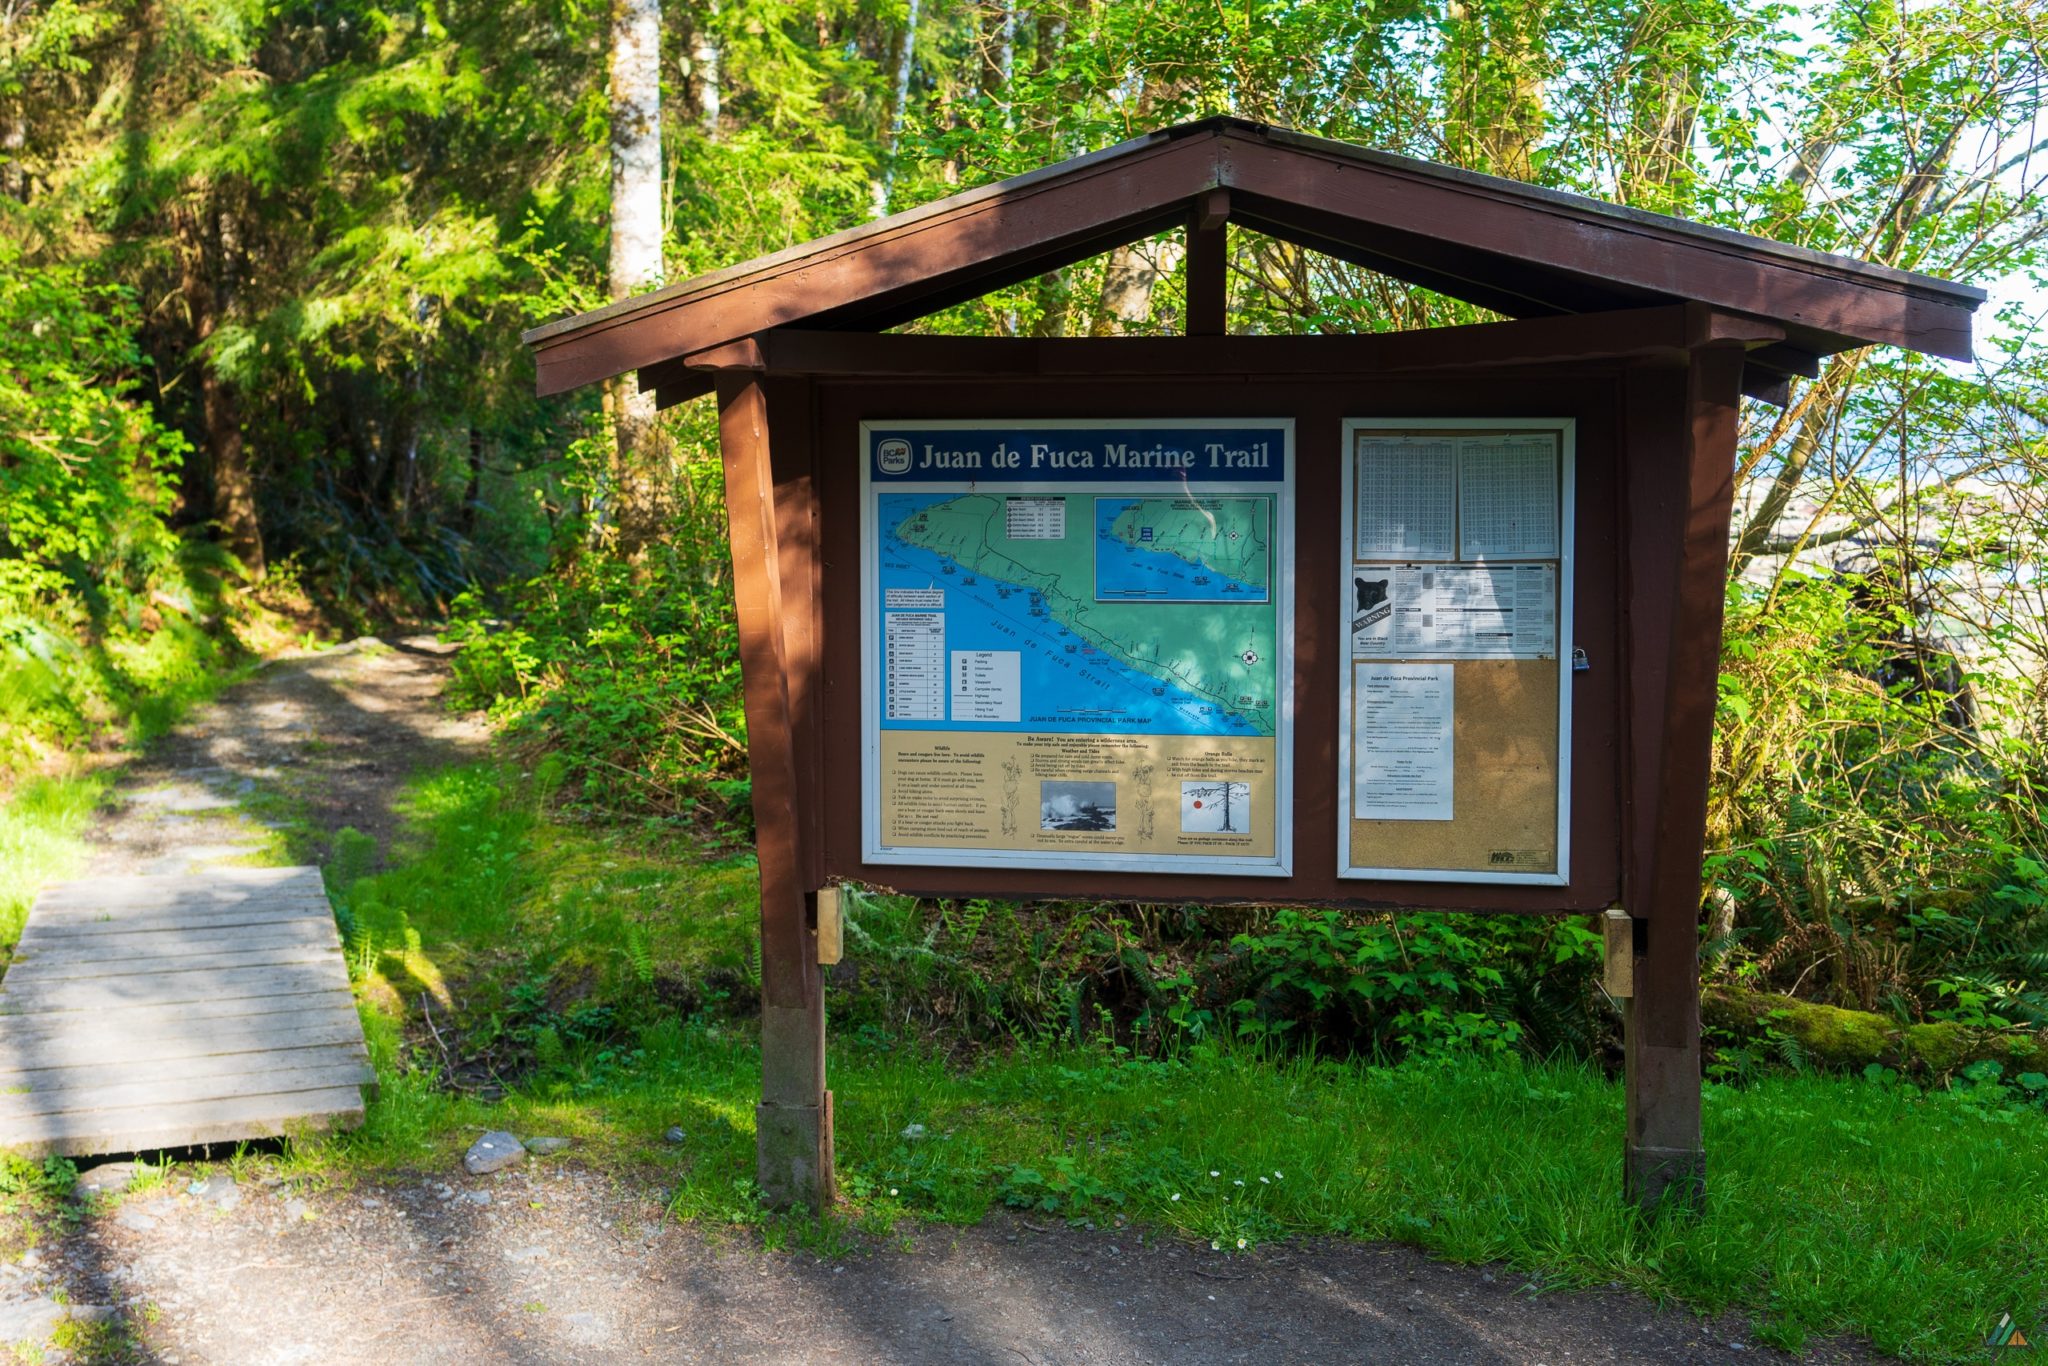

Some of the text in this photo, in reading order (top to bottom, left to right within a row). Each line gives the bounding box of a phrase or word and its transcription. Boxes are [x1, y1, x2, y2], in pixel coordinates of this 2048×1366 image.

[883, 457, 905, 465] Parks
[920, 441, 1269, 469] Juan de Fuca Marine Trail
[1355, 607, 1390, 629] WARNING
[991, 619, 1110, 690] Juan de Fuca Strait
